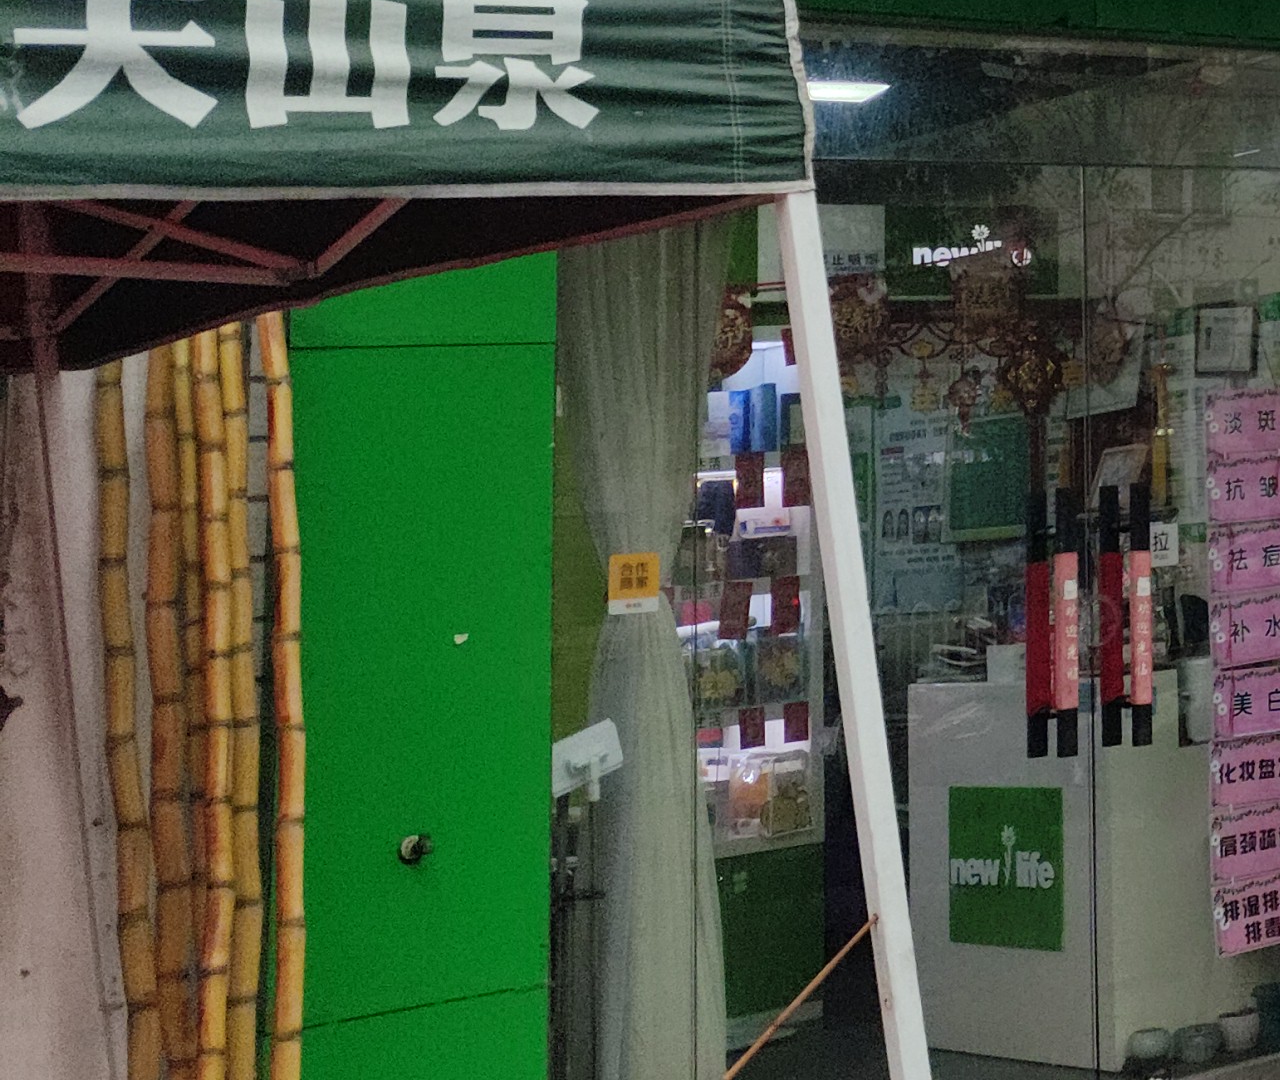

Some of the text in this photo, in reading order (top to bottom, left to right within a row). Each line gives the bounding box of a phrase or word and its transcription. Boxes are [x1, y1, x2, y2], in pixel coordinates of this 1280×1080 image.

[1223, 409, 1277, 435] 淡斑
[1224, 475, 1279, 502] 抗皱
[1152, 530, 1171, 553] 拉
